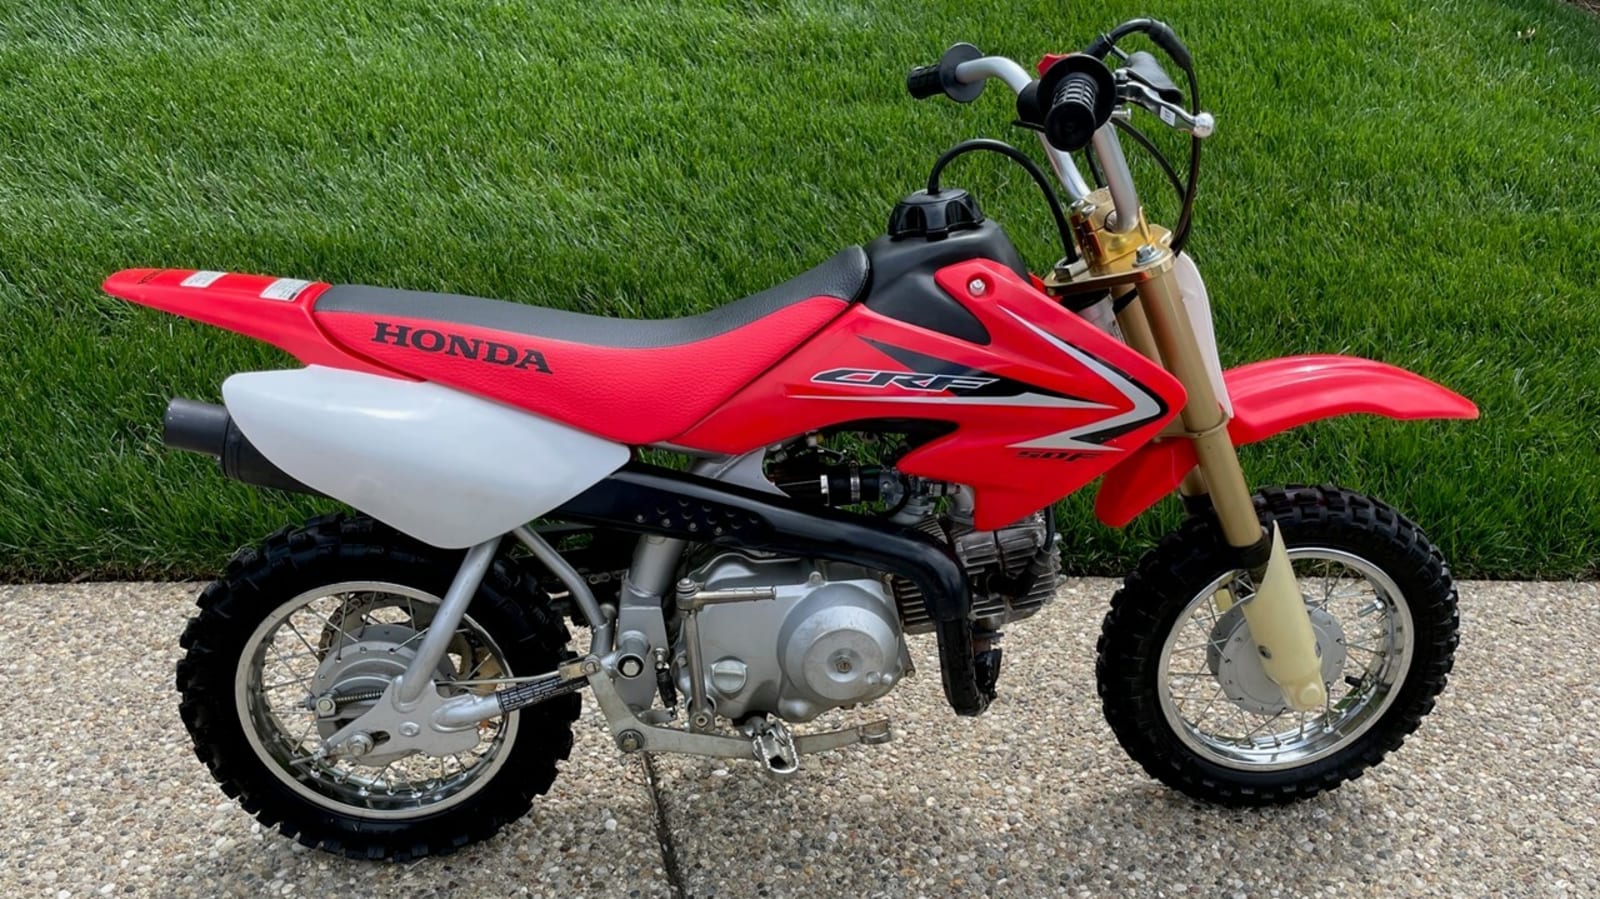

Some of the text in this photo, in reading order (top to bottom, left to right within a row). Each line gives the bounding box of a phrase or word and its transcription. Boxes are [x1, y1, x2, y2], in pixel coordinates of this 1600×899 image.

[371, 321, 553, 375] HONDA
[810, 367, 1001, 392] CRF
[1017, 450, 1104, 462] 50F
